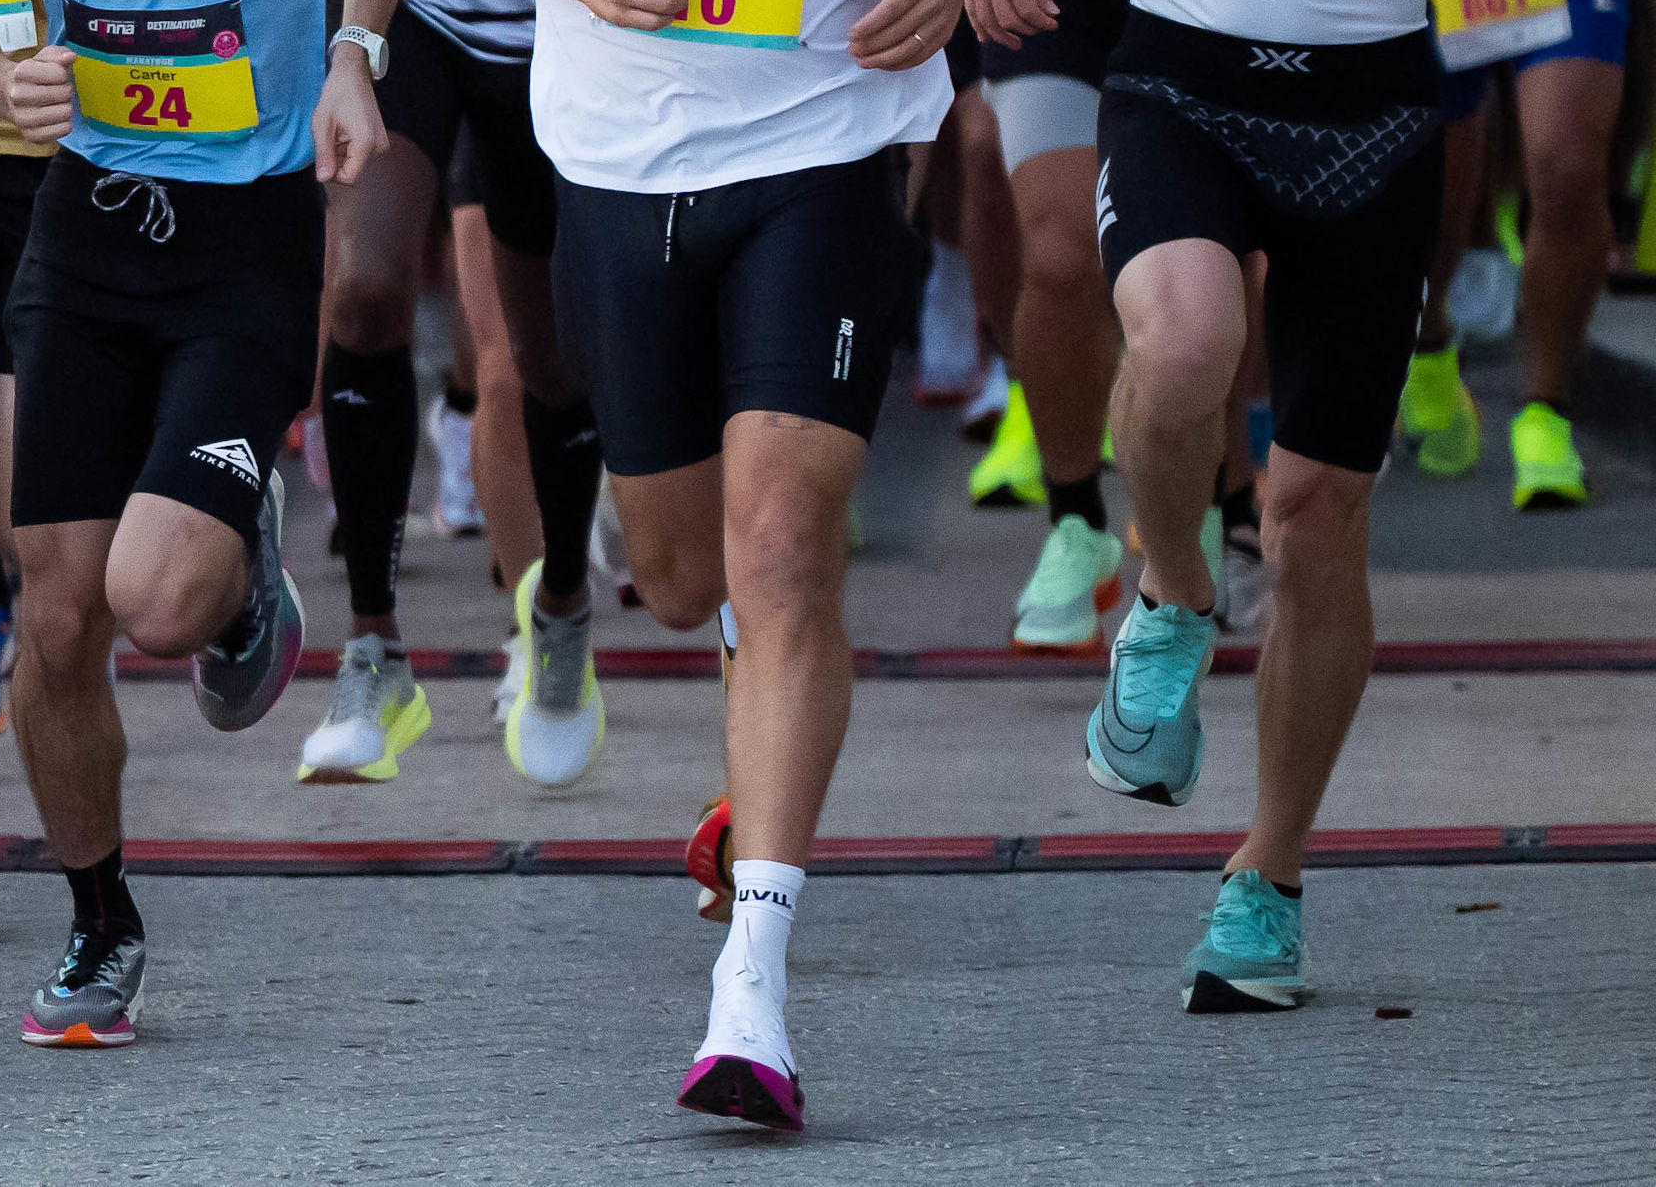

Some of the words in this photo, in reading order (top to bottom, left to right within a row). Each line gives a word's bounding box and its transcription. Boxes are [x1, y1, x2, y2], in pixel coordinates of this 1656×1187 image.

[147, 18, 206, 32] DESTINATION:
[129, 69, 177, 82] Carter
[124, 84, 192, 128] 24
[189, 450, 227, 470] NIKE
[232, 466, 260, 491] TRAIL
[738, 889, 789, 907] UVU
